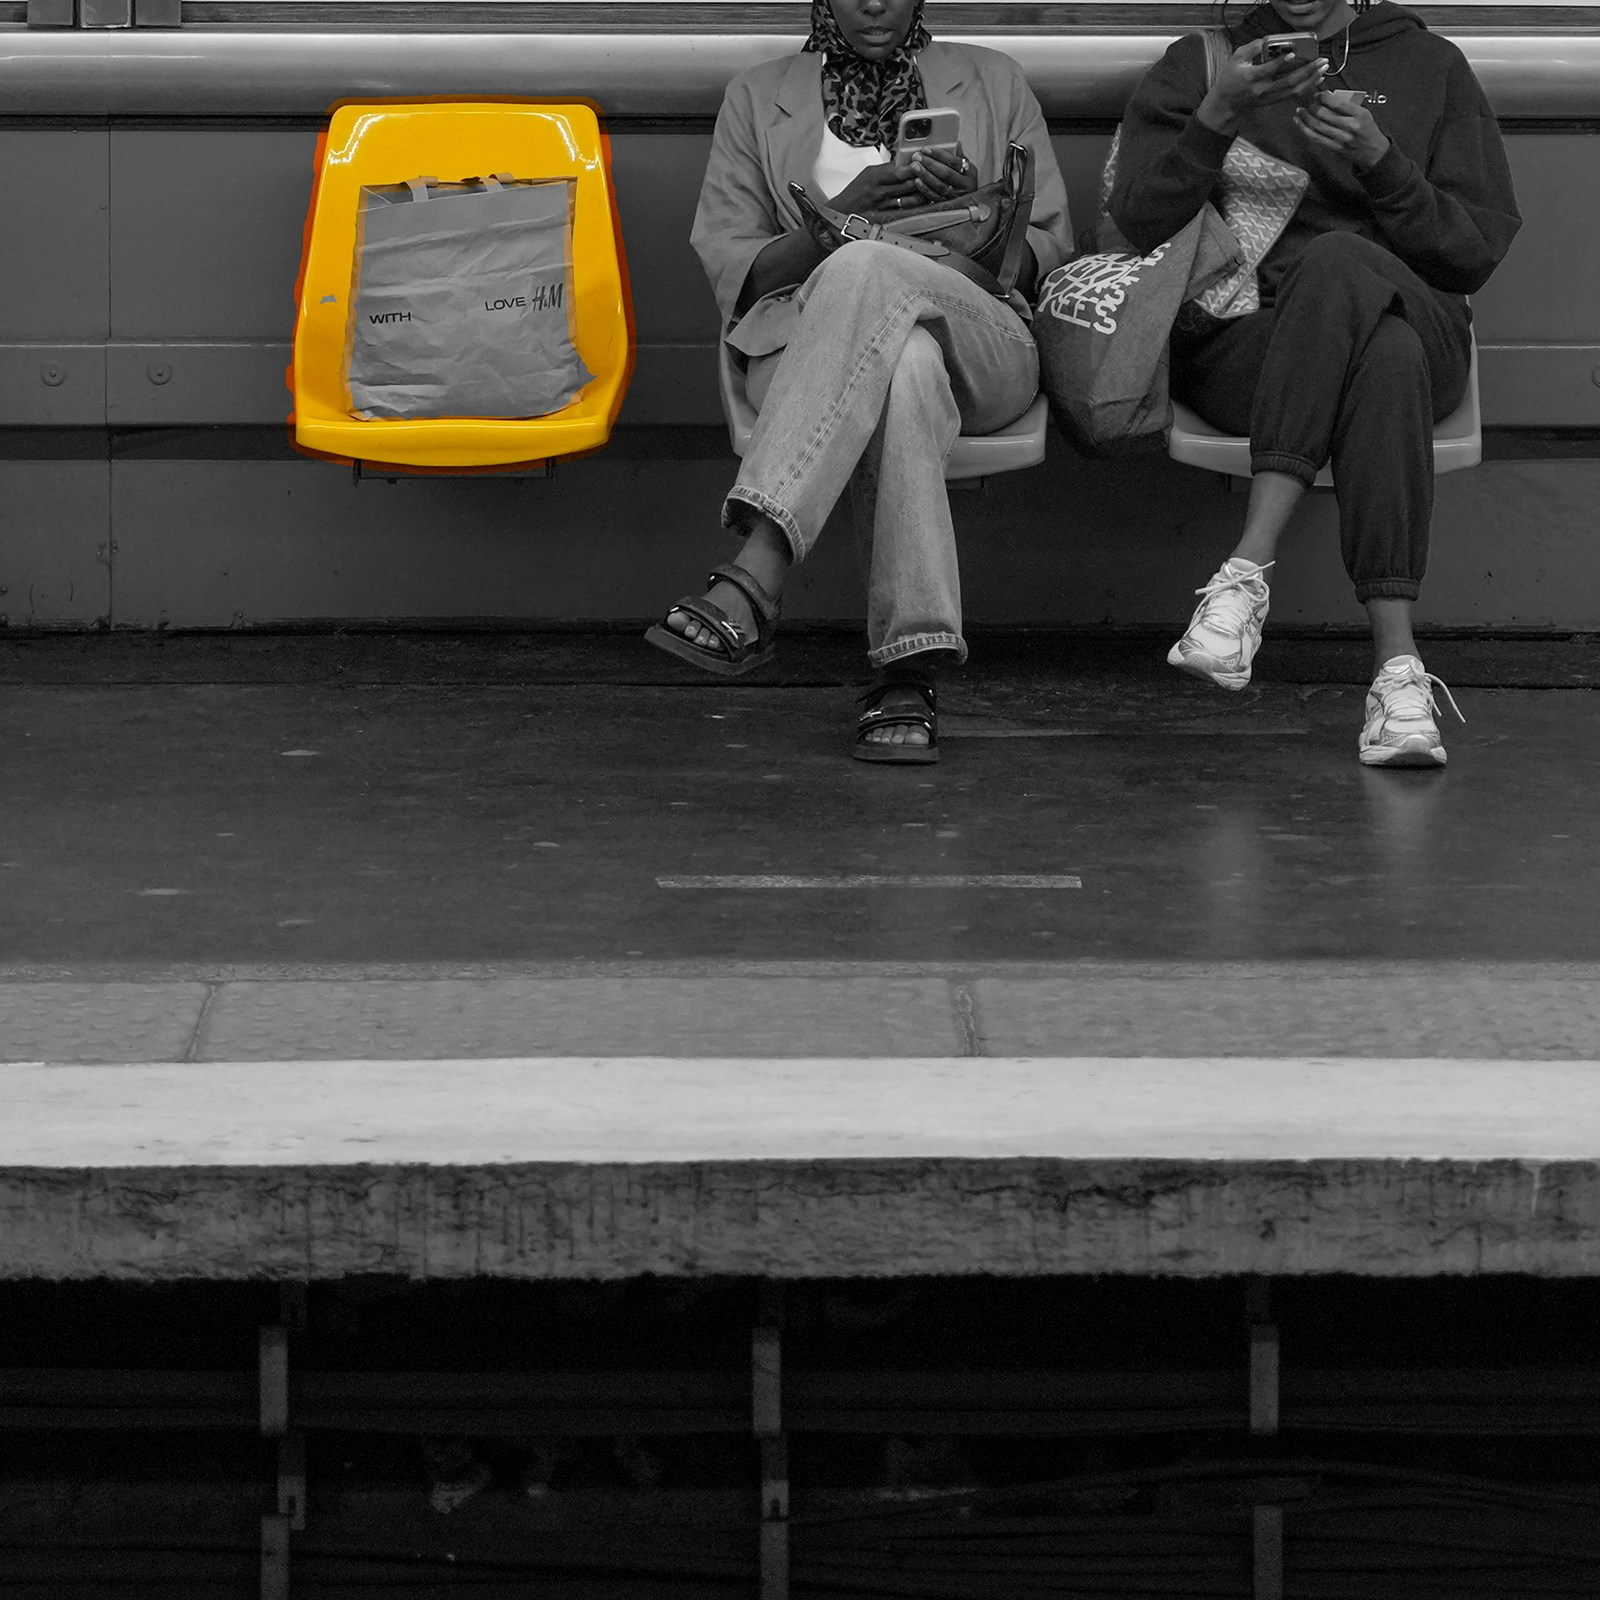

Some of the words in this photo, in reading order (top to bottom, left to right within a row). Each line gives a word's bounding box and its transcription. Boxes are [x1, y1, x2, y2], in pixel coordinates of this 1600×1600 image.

[369, 312, 411, 324] WITH
[485, 297, 526, 311] LOVE
[532, 283, 563, 311] H&M
